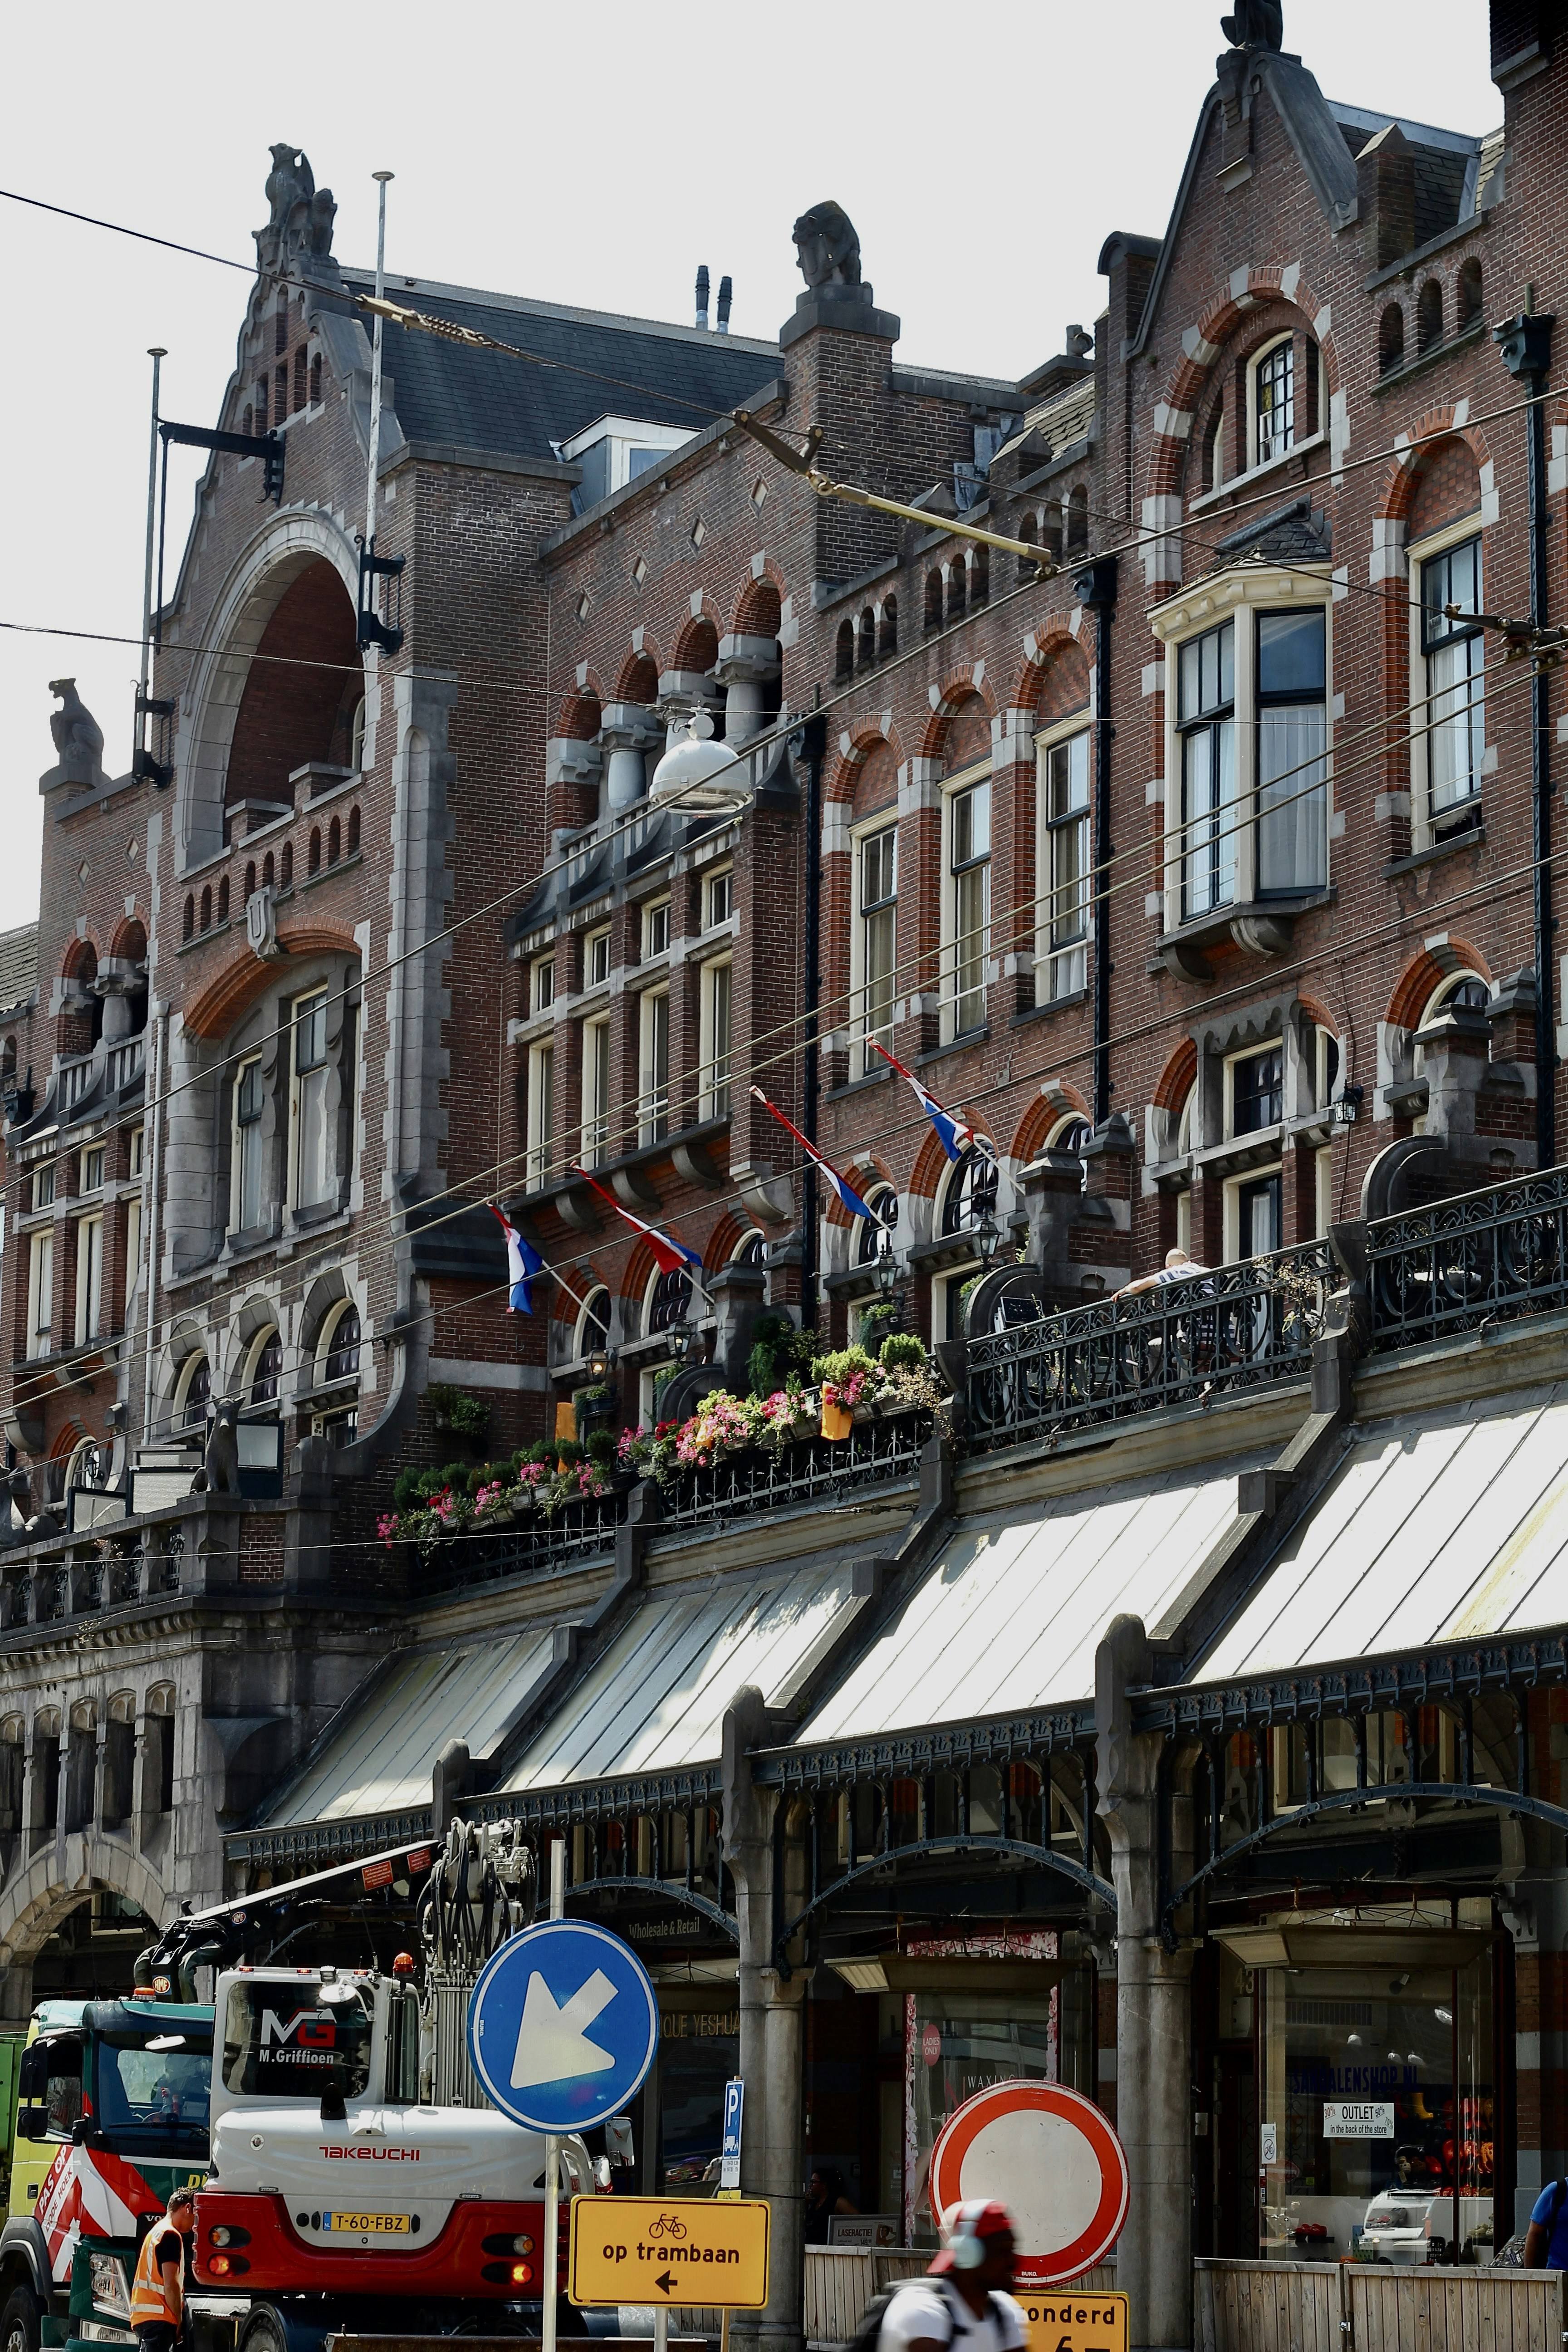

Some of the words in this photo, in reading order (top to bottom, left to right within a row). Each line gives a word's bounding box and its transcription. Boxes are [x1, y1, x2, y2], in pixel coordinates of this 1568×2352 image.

[233, 1913, 245, 1922] HMF
[629, 1920, 668, 1939] Wholesale
[669, 1921, 675, 1935] &
[676, 1916, 700, 1934] Retail
[154, 1979, 167, 1990] HMF
[923, 2037, 940, 2046] LADIES
[260, 2049, 334, 2064] M.Griffioen
[727, 2088, 738, 2127] P
[1324, 2105, 1336, 2118] 30%
[1342, 2106, 1374, 2119] OUTLET
[1375, 2105, 1385, 2117] 50%
[1330, 2125, 1335, 2133] in
[1346, 2125, 1357, 2133] back
[1359, 2125, 1364, 2133] of
[319, 2146, 420, 2161] TAKEUCHI
[38, 2174, 54, 2215] PAS
[54, 2145, 67, 2174] OP
[45, 2201, 59, 2233] DODE
[58, 2167, 73, 2200] HOEK
[336, 2216, 403, 2230] T-60-FBZ
[838, 2229, 872, 2237] LASERACTIE!
[603, 2245, 627, 2263] op
[637, 2242, 740, 2264] trambaan
[1026, 2304, 1114, 2325] onderd
